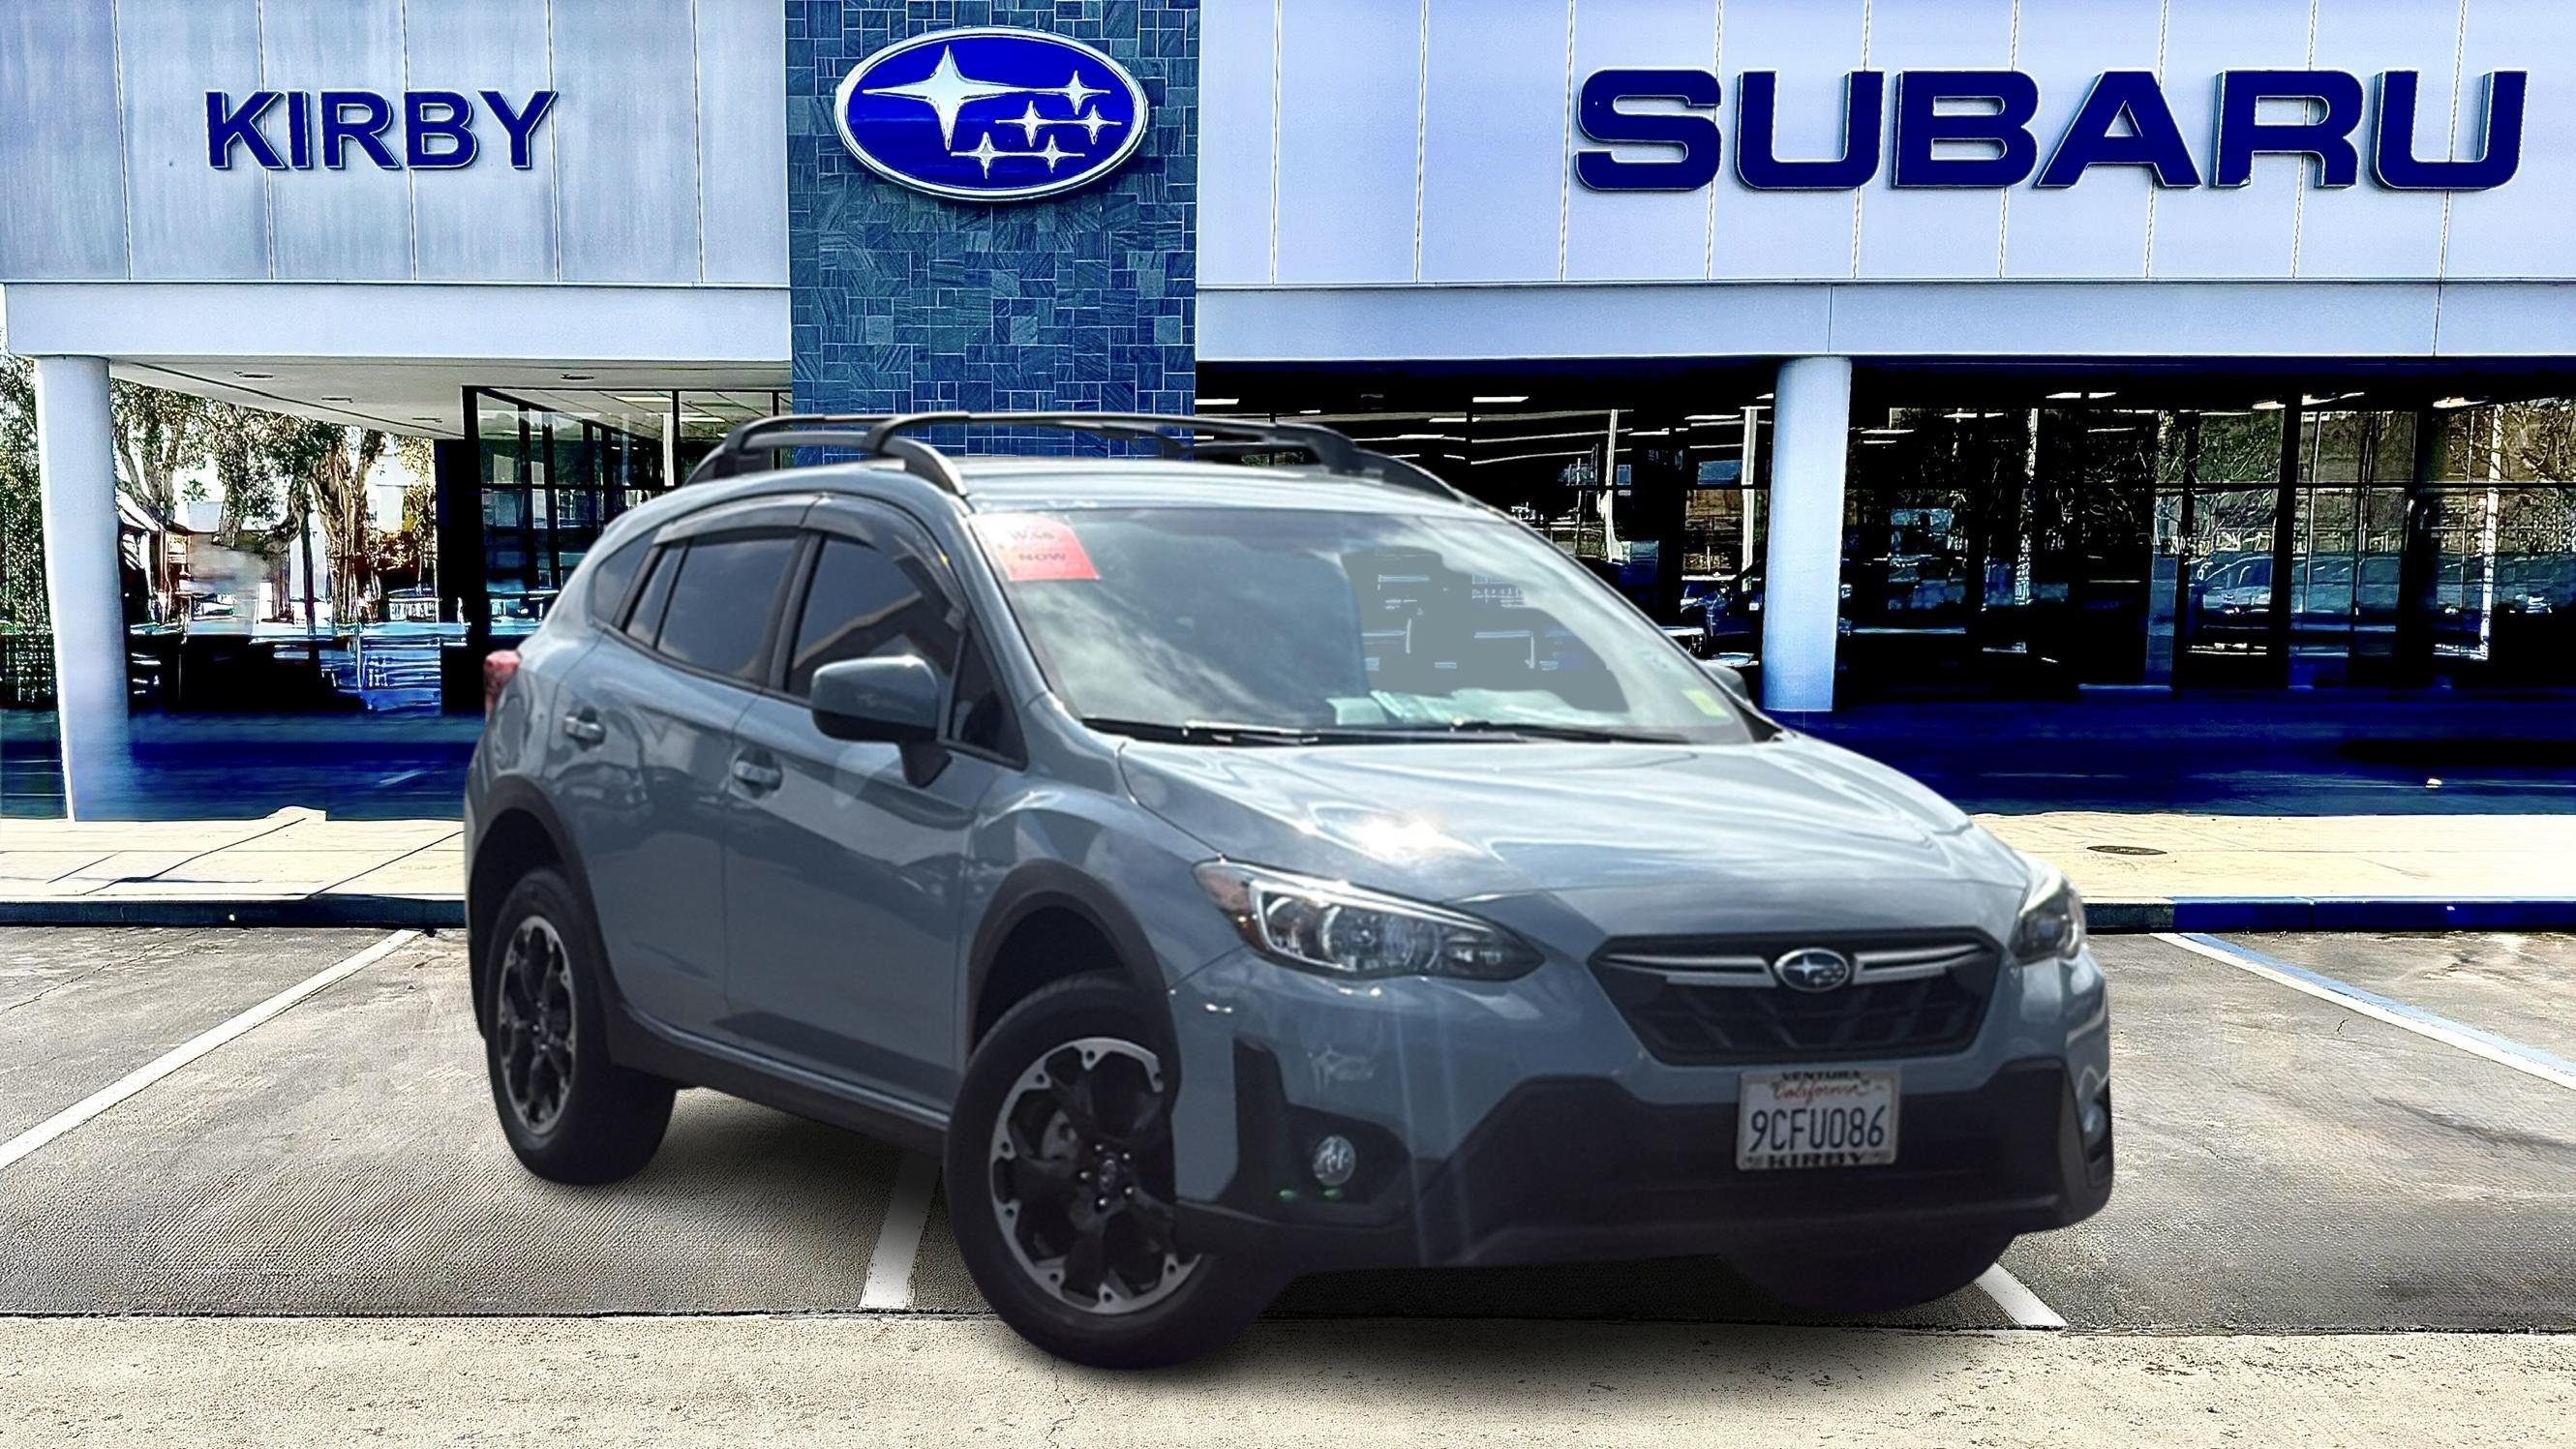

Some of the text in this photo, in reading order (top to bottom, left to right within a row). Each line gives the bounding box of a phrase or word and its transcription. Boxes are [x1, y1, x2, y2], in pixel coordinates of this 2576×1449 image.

[204, 90, 560, 170] KIRBY
[1575, 68, 2529, 191] SUBARU
[1017, 552, 1068, 562] NOW
[1772, 1079, 1869, 1105] California
[1747, 1104, 1888, 1153] 9CFU086
